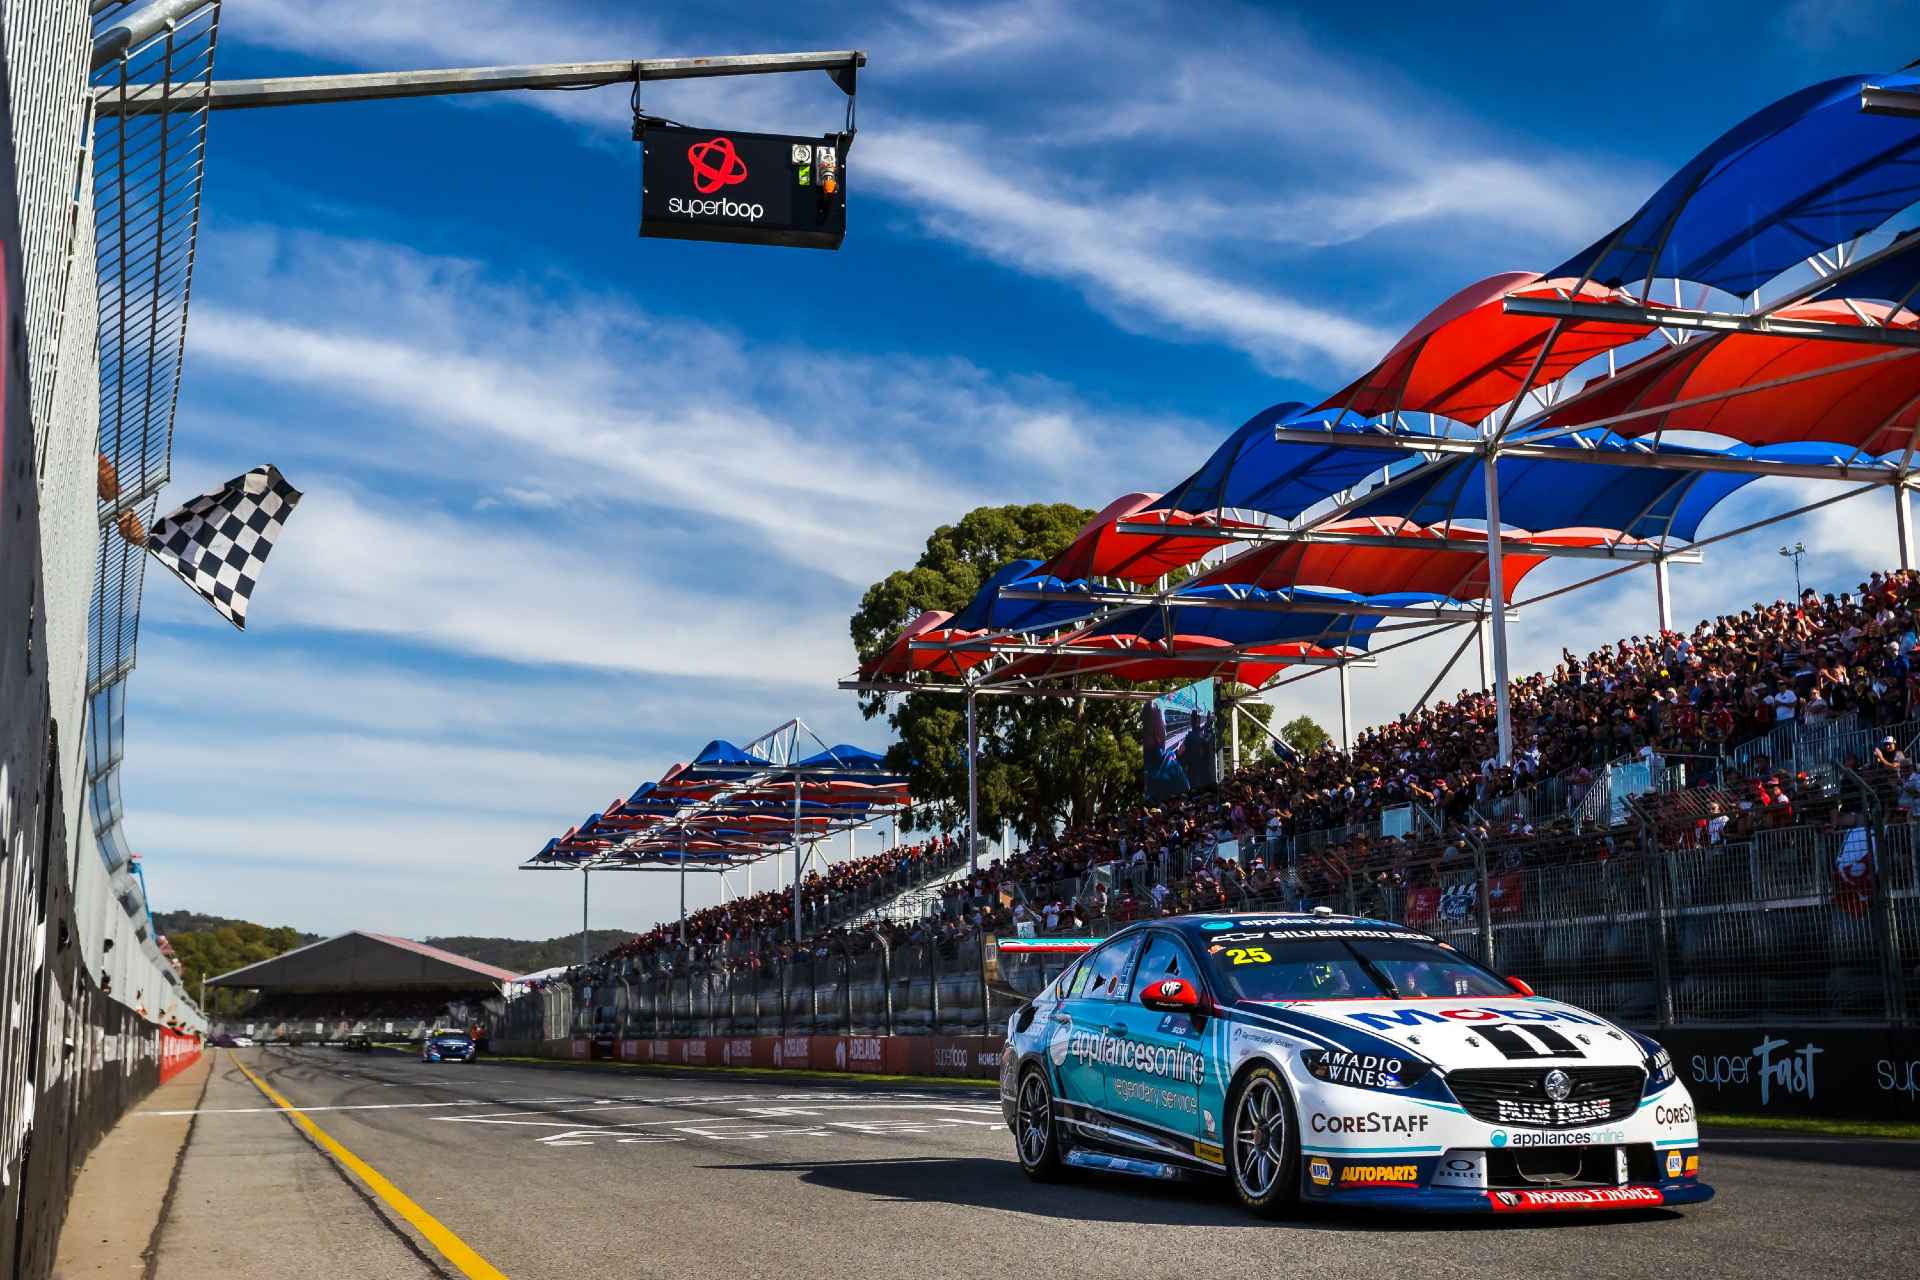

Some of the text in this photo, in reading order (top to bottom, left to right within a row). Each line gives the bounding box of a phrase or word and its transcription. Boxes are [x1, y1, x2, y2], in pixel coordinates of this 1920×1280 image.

[668, 196, 764, 222] superloop
[1269, 930, 1389, 940] SILVERADO
[1226, 947, 1273, 965] 25
[1344, 1007, 1607, 1032] Mobil
[851, 1039, 881, 1060] ADELAIDE
[1496, 1024, 1555, 1056] 1
[1071, 1027, 1205, 1085] appliancesonline
[1320, 1051, 1403, 1074] AMADIO
[1328, 1066, 1387, 1088] WINES
[1691, 1035, 1825, 1105] super Fast
[1161, 1087, 1198, 1115] service
[1311, 1112, 1429, 1133] CORESTAFF
[1512, 1129, 1625, 1148] appliancesonline
[1312, 1164, 1329, 1179] NAPA
[1341, 1165, 1418, 1182] AUTOPARTS
[1524, 1186, 1659, 1204] MORRIS FINANCE
